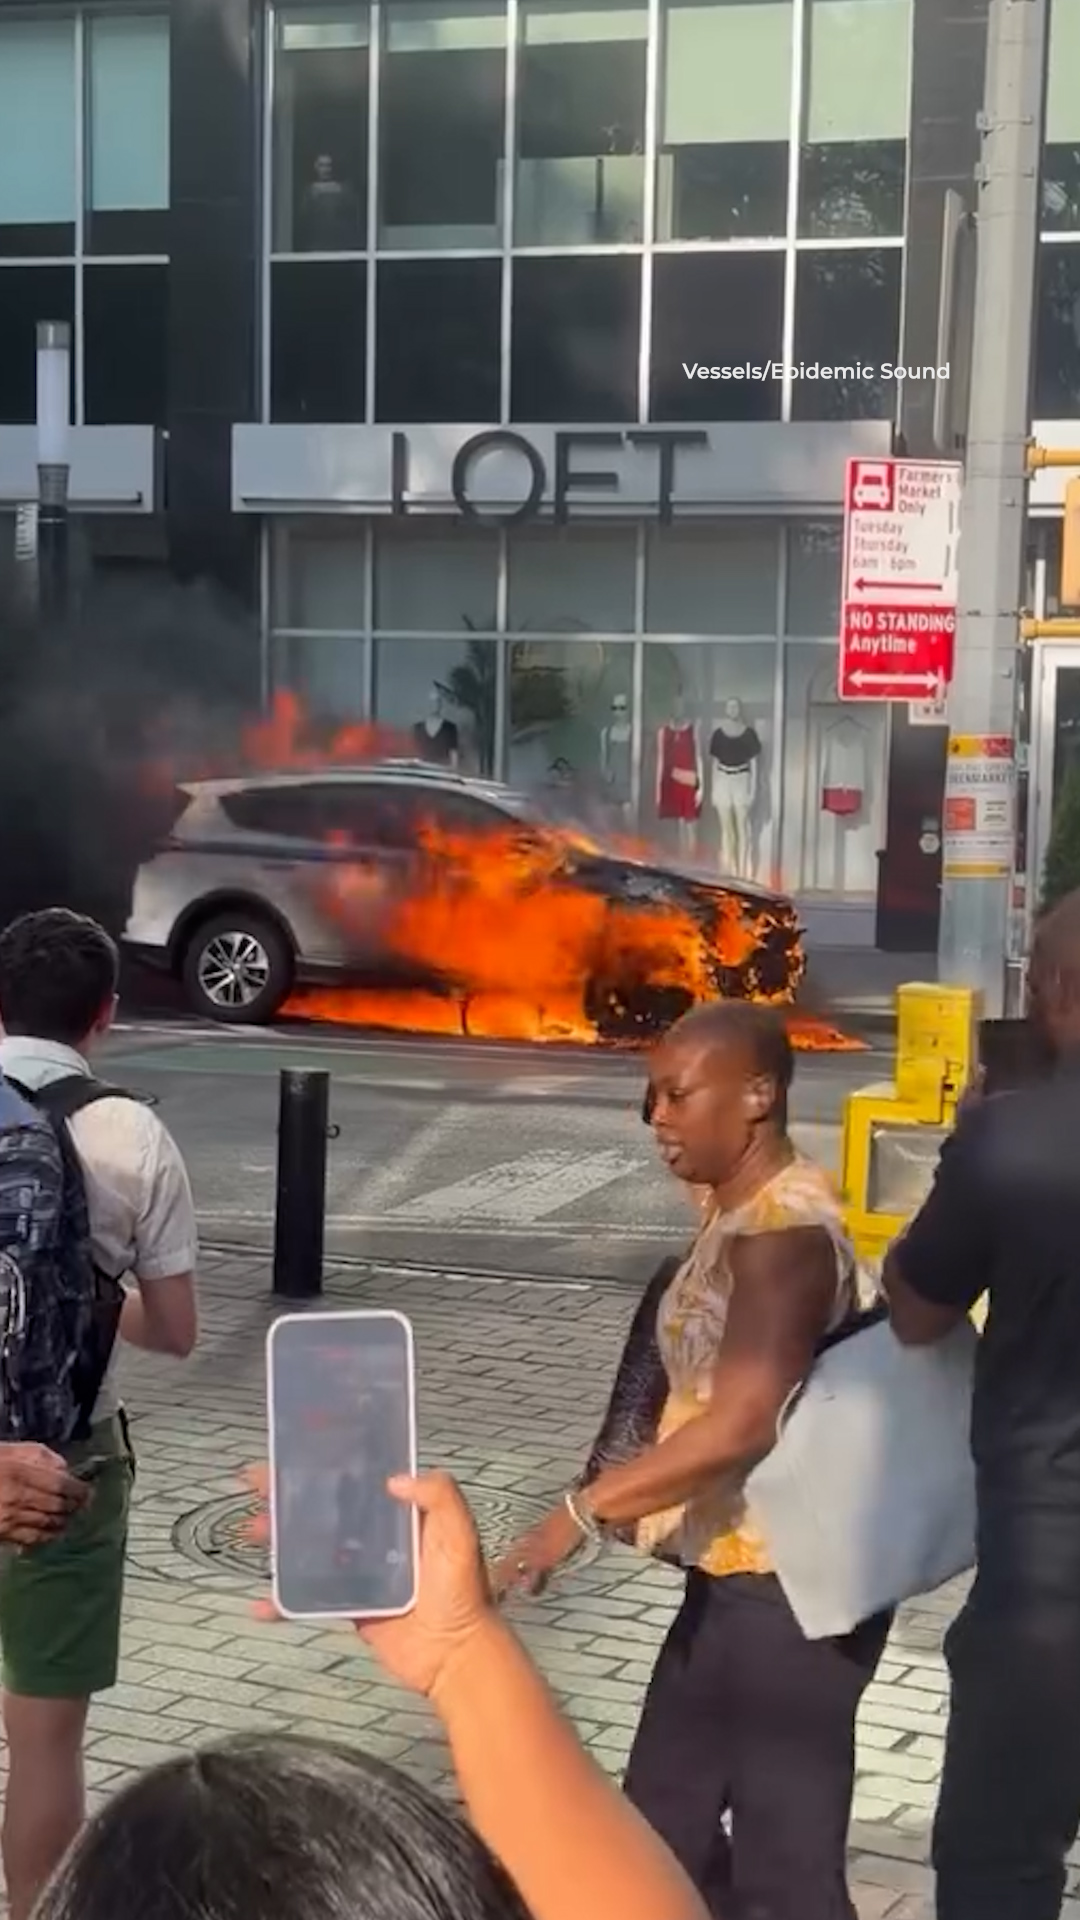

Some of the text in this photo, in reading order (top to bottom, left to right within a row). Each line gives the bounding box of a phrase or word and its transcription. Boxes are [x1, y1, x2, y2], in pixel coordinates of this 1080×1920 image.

[392, 430, 708, 525] LOFT
[899, 484, 942, 499] Market
[898, 499, 926, 517] Only
[854, 519, 903, 535] Tuesday
[854, 536, 908, 554] Thursday
[849, 611, 955, 633] NO STANDING
[849, 632, 917, 657] Anytime
